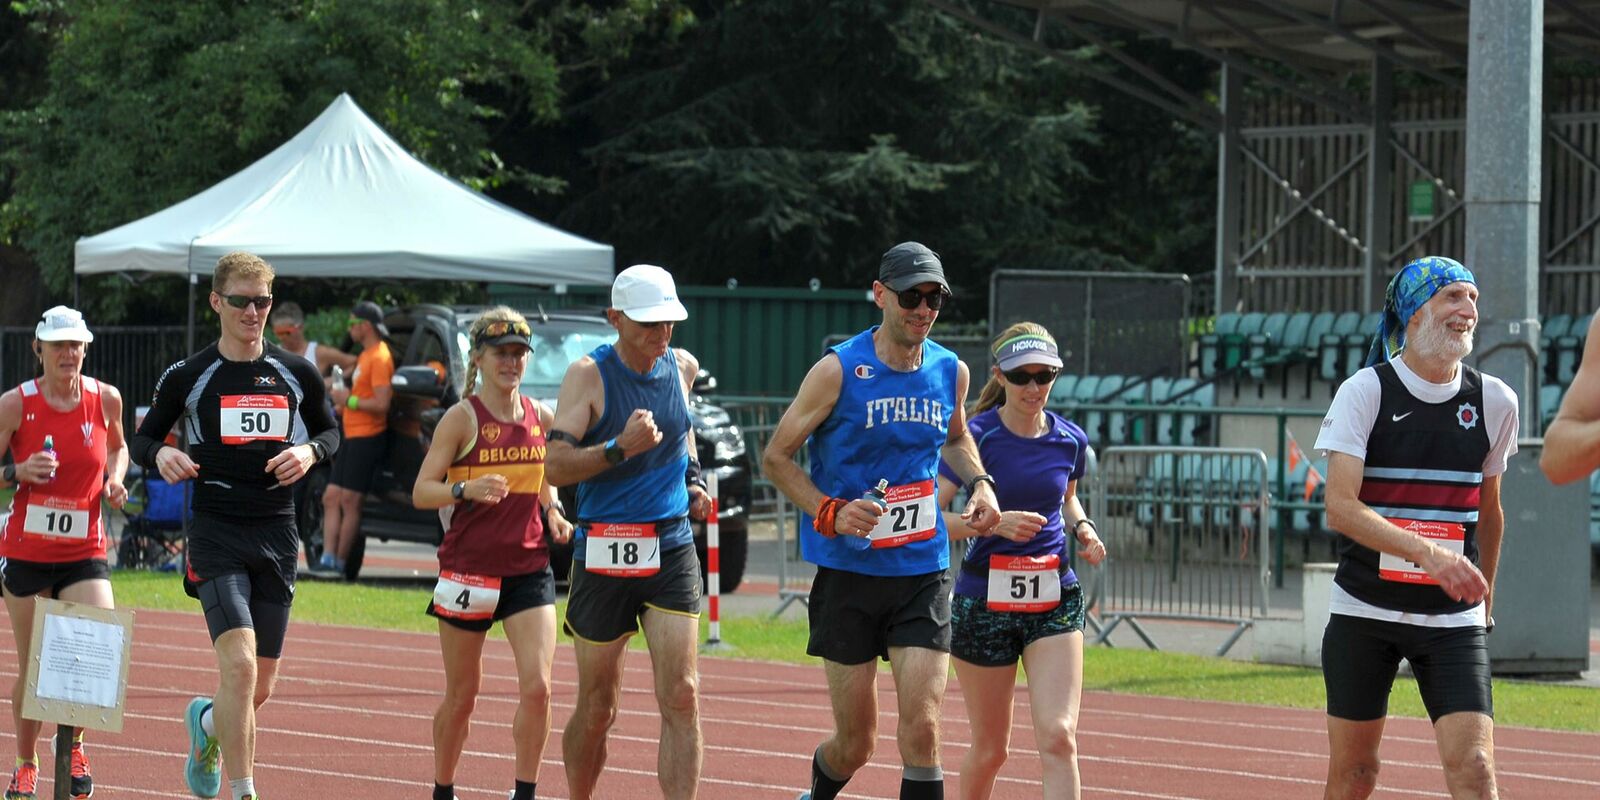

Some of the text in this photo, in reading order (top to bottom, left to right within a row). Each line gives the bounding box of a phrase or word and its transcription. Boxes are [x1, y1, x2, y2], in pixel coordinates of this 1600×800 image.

[240, 411, 271, 433] 50
[865, 396, 943, 432] ITALIA
[46, 511, 73, 533] 10
[890, 503, 919, 533] 27
[608, 542, 638, 565] 18
[1010, 575, 1039, 599] 51
[455, 588, 471, 610] 4
